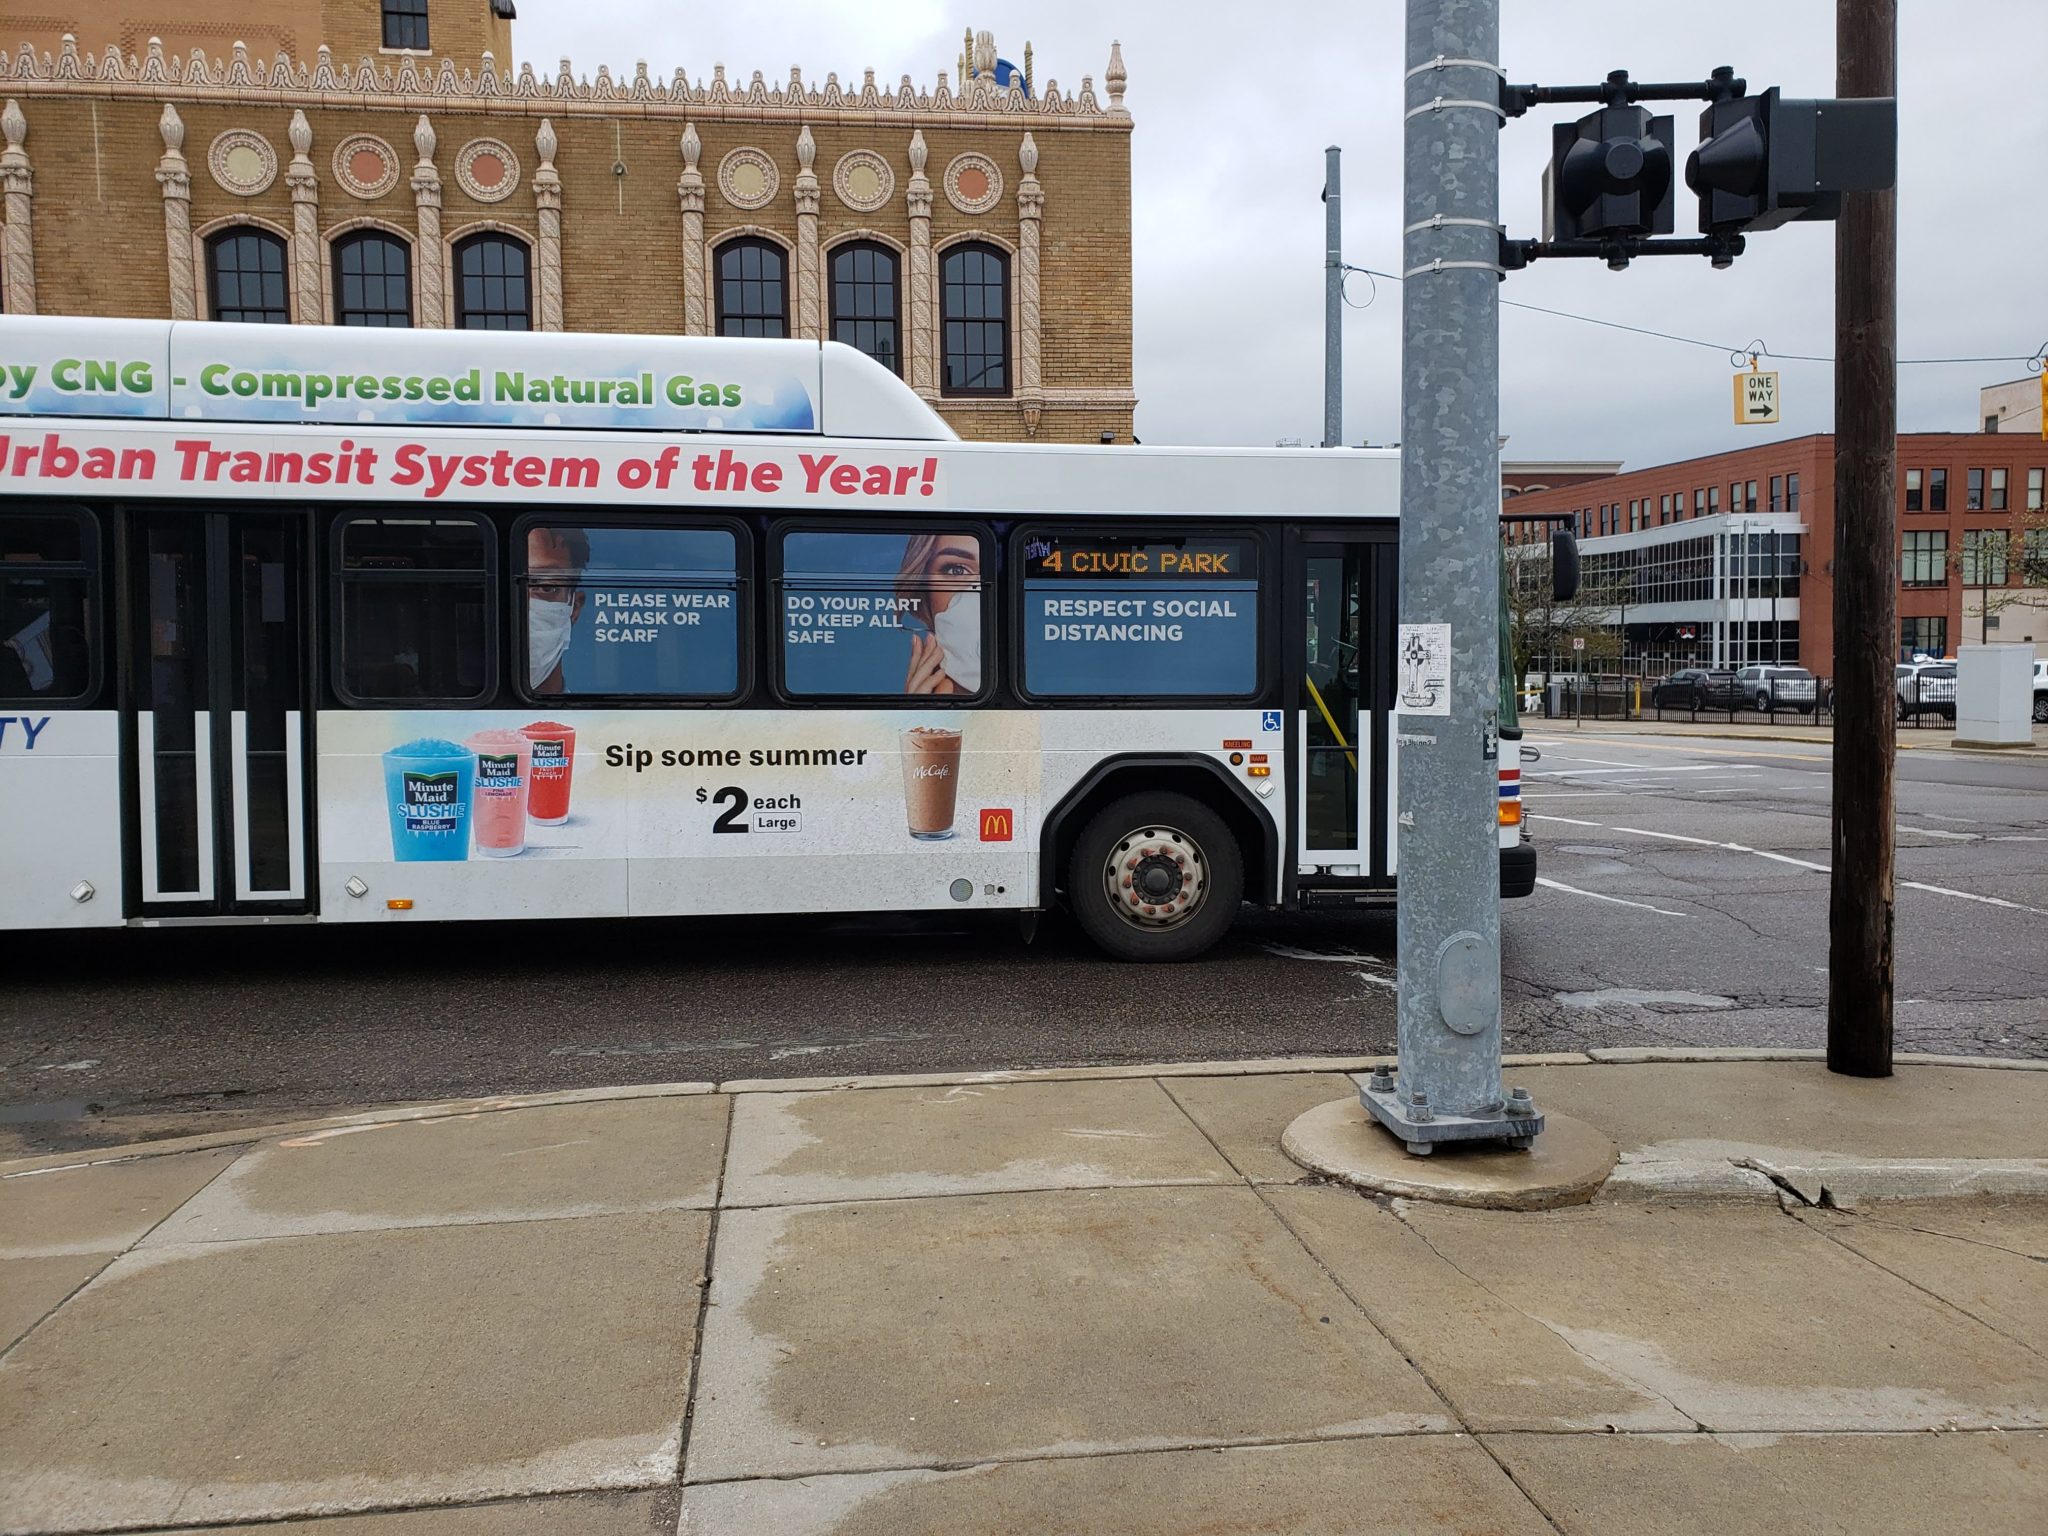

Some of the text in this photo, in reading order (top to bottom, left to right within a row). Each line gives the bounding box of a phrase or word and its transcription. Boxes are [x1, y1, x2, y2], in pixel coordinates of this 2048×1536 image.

[0, 365, 38, 399] y
[51, 358, 153, 392] CNG
[200, 363, 481, 408] Compressed
[494, 371, 656, 405] Natural
[666, 375, 742, 407] Gas
[1749, 377, 1772, 389] ONE
[1749, 390, 1773, 402] WAY
[174, 439, 378, 485] Transit
[389, 443, 601, 498] System
[617, 446, 680, 490] of
[692, 449, 783, 493] the
[798, 454, 938, 497] Year!
[1042, 551, 1230, 573] 4 CIVIC PARK
[595, 594, 730, 608] PLEASE WEAR
[788, 597, 922, 612] DO YOUR PART
[1044, 600, 1237, 617] RESPECT SOCIAL
[595, 612, 701, 626] A MASK OR
[788, 614, 904, 629] TO KEEP ALL
[595, 629, 658, 643] SCARF
[788, 631, 836, 645] SAFE
[1044, 624, 1183, 642] DISTANCING
[482, 760, 516, 769] Minute
[531, 758, 569, 767] LUSHIE
[605, 744, 868, 773] Sip some summer
[409, 782, 454, 793] Minute
[474, 777, 523, 788] SLUSHIE
[415, 792, 447, 802] Maid
[753, 794, 801, 809] each
[398, 804, 466, 818] SLUSHIE
[758, 818, 796, 829] Large
